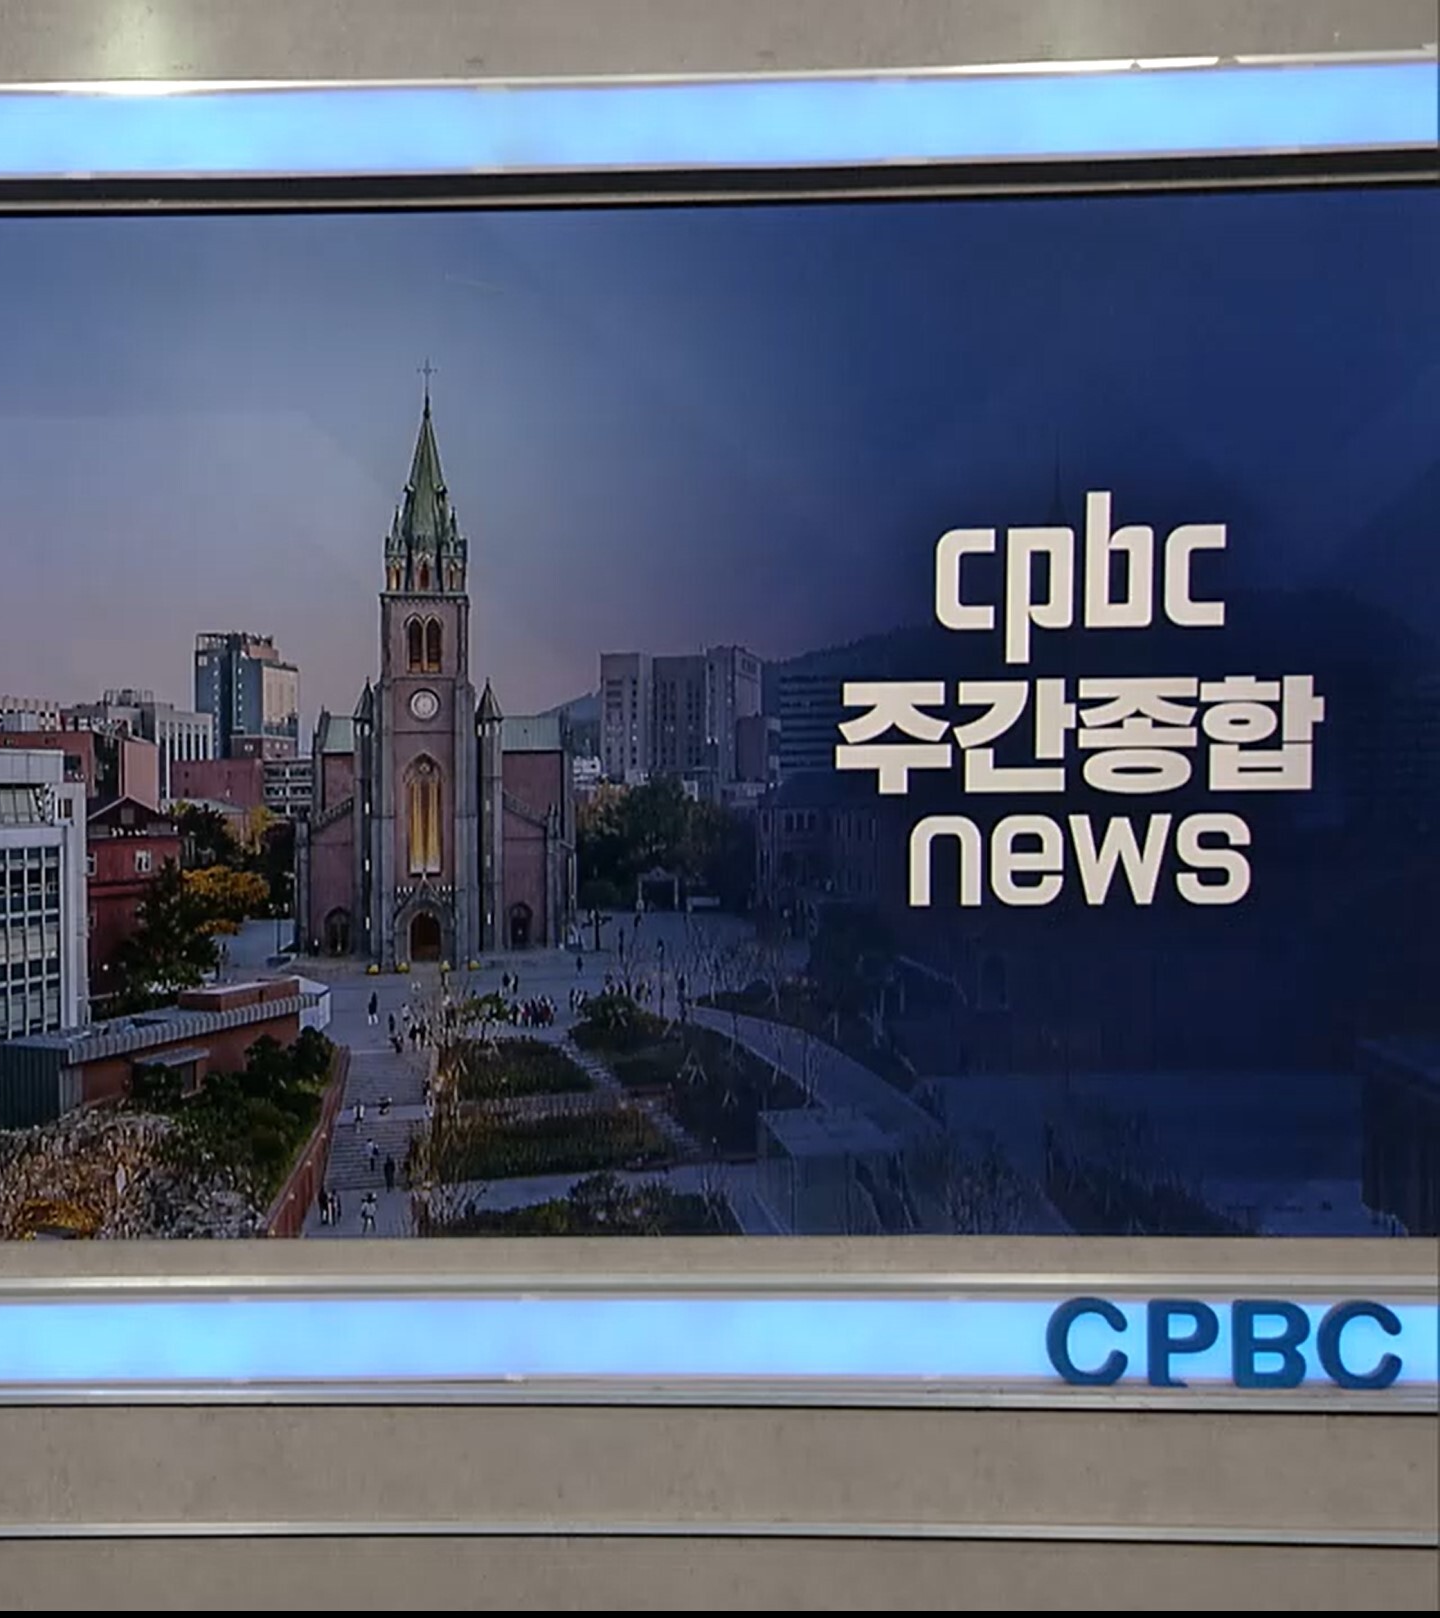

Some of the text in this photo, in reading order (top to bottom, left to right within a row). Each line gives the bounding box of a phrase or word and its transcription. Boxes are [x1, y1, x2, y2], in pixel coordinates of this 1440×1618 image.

[934, 491, 1227, 664] cpbc
[835, 675, 1326, 795] 주간종합
[909, 812, 1252, 907] news
[1046, 1296, 1403, 1390] CPBC
